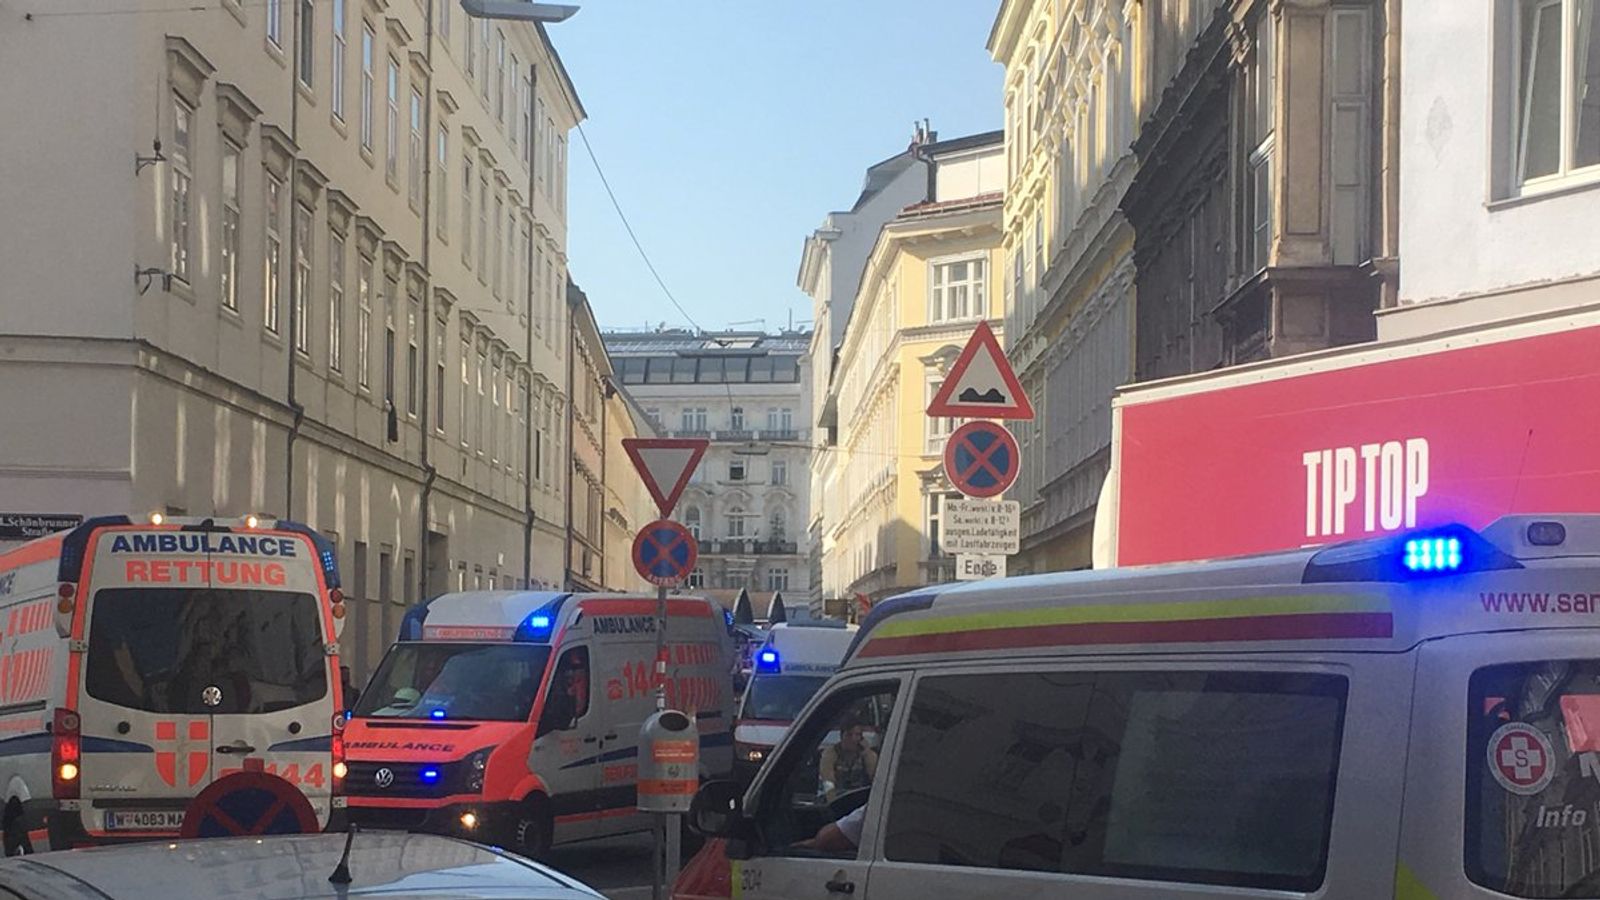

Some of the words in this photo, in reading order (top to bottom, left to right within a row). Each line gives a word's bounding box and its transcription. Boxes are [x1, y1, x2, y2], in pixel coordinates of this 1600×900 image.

[1303, 447, 1357, 537] TIP
[1361, 438, 1429, 532] TOP
[111, 534, 297, 557] AMBULANCE
[126, 560, 286, 586] RETTUNG
[593, 617, 656, 634] AMBULANCE
[1536, 804, 1586, 828] Info
